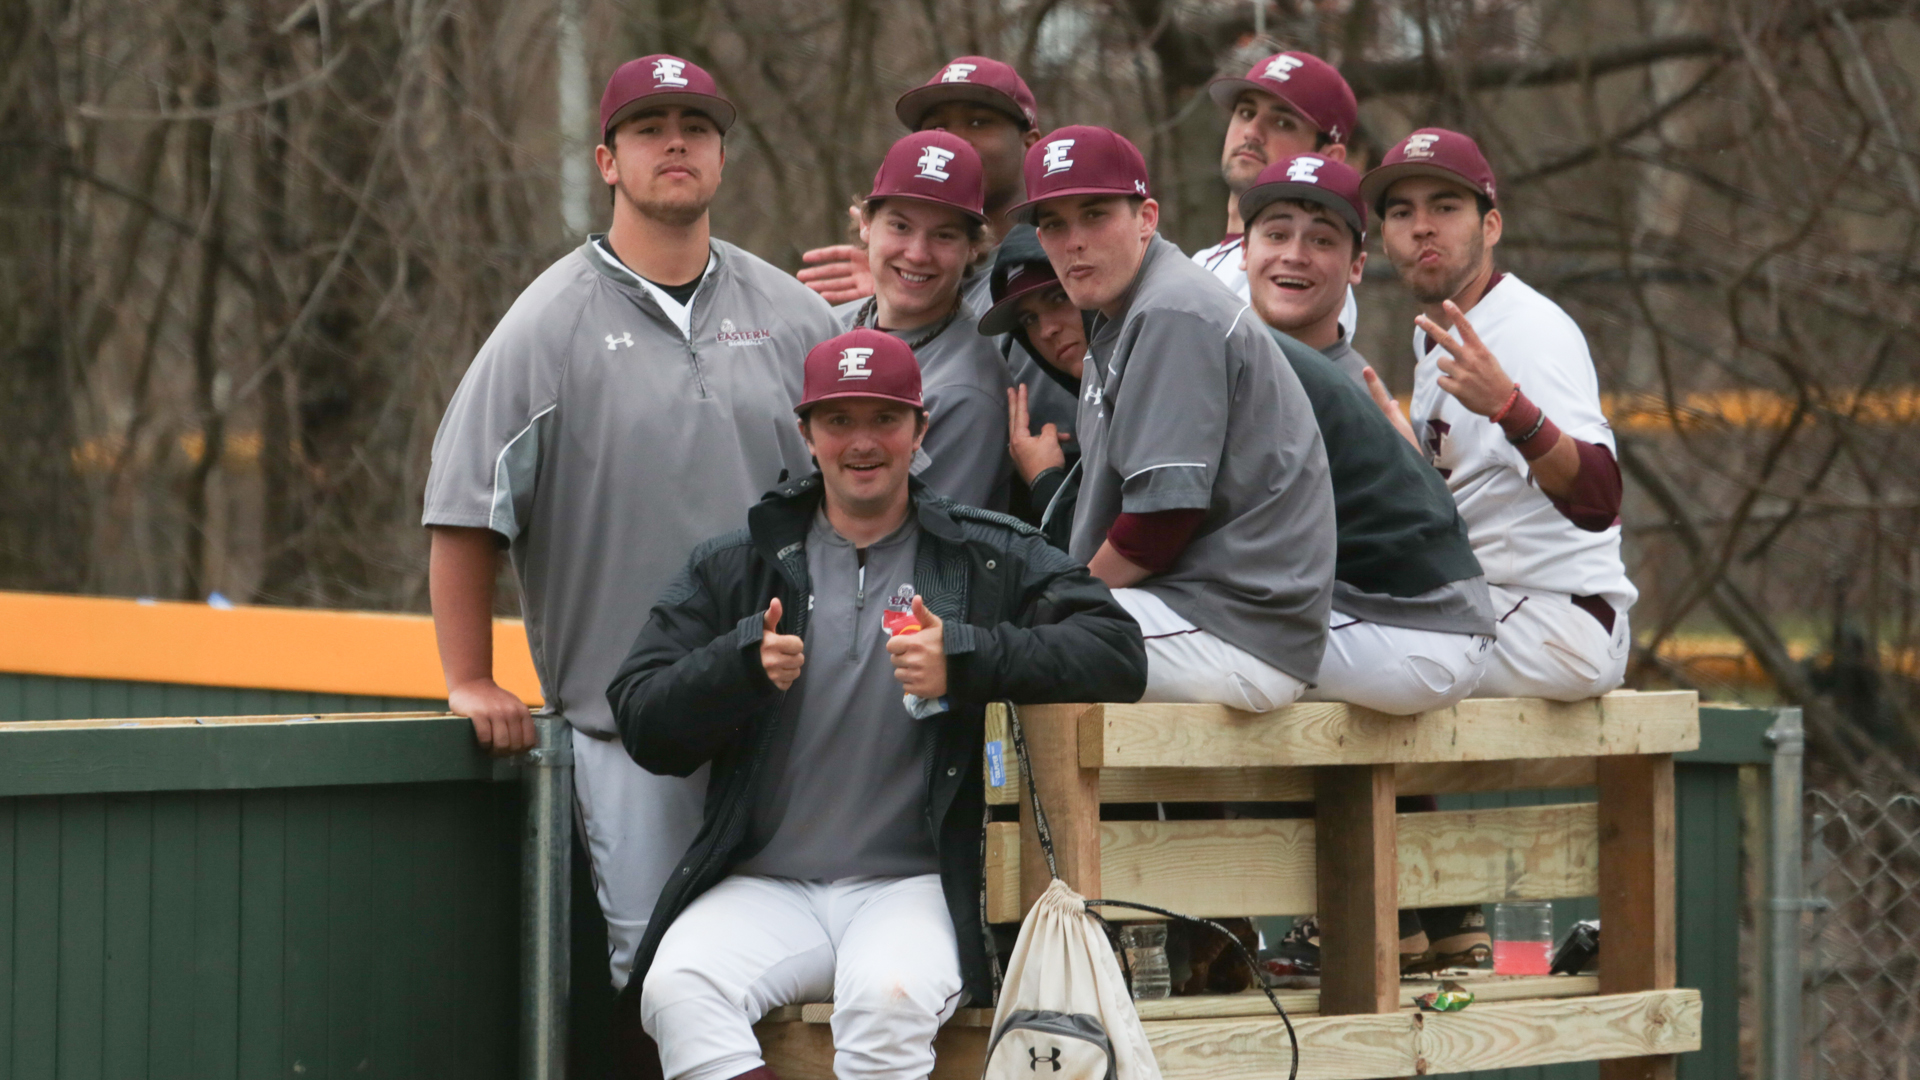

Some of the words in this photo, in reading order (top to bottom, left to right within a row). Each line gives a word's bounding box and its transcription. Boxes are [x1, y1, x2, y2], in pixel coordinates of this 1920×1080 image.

[652, 59, 688, 88] E
[1260, 54, 1304, 82] E
[1043, 139, 1075, 178] E
[1403, 134, 1439, 162] E
[914, 146, 955, 182] E
[1286, 157, 1326, 184] E
[717, 329, 770, 343] EASTERN
[838, 347, 874, 381] E
